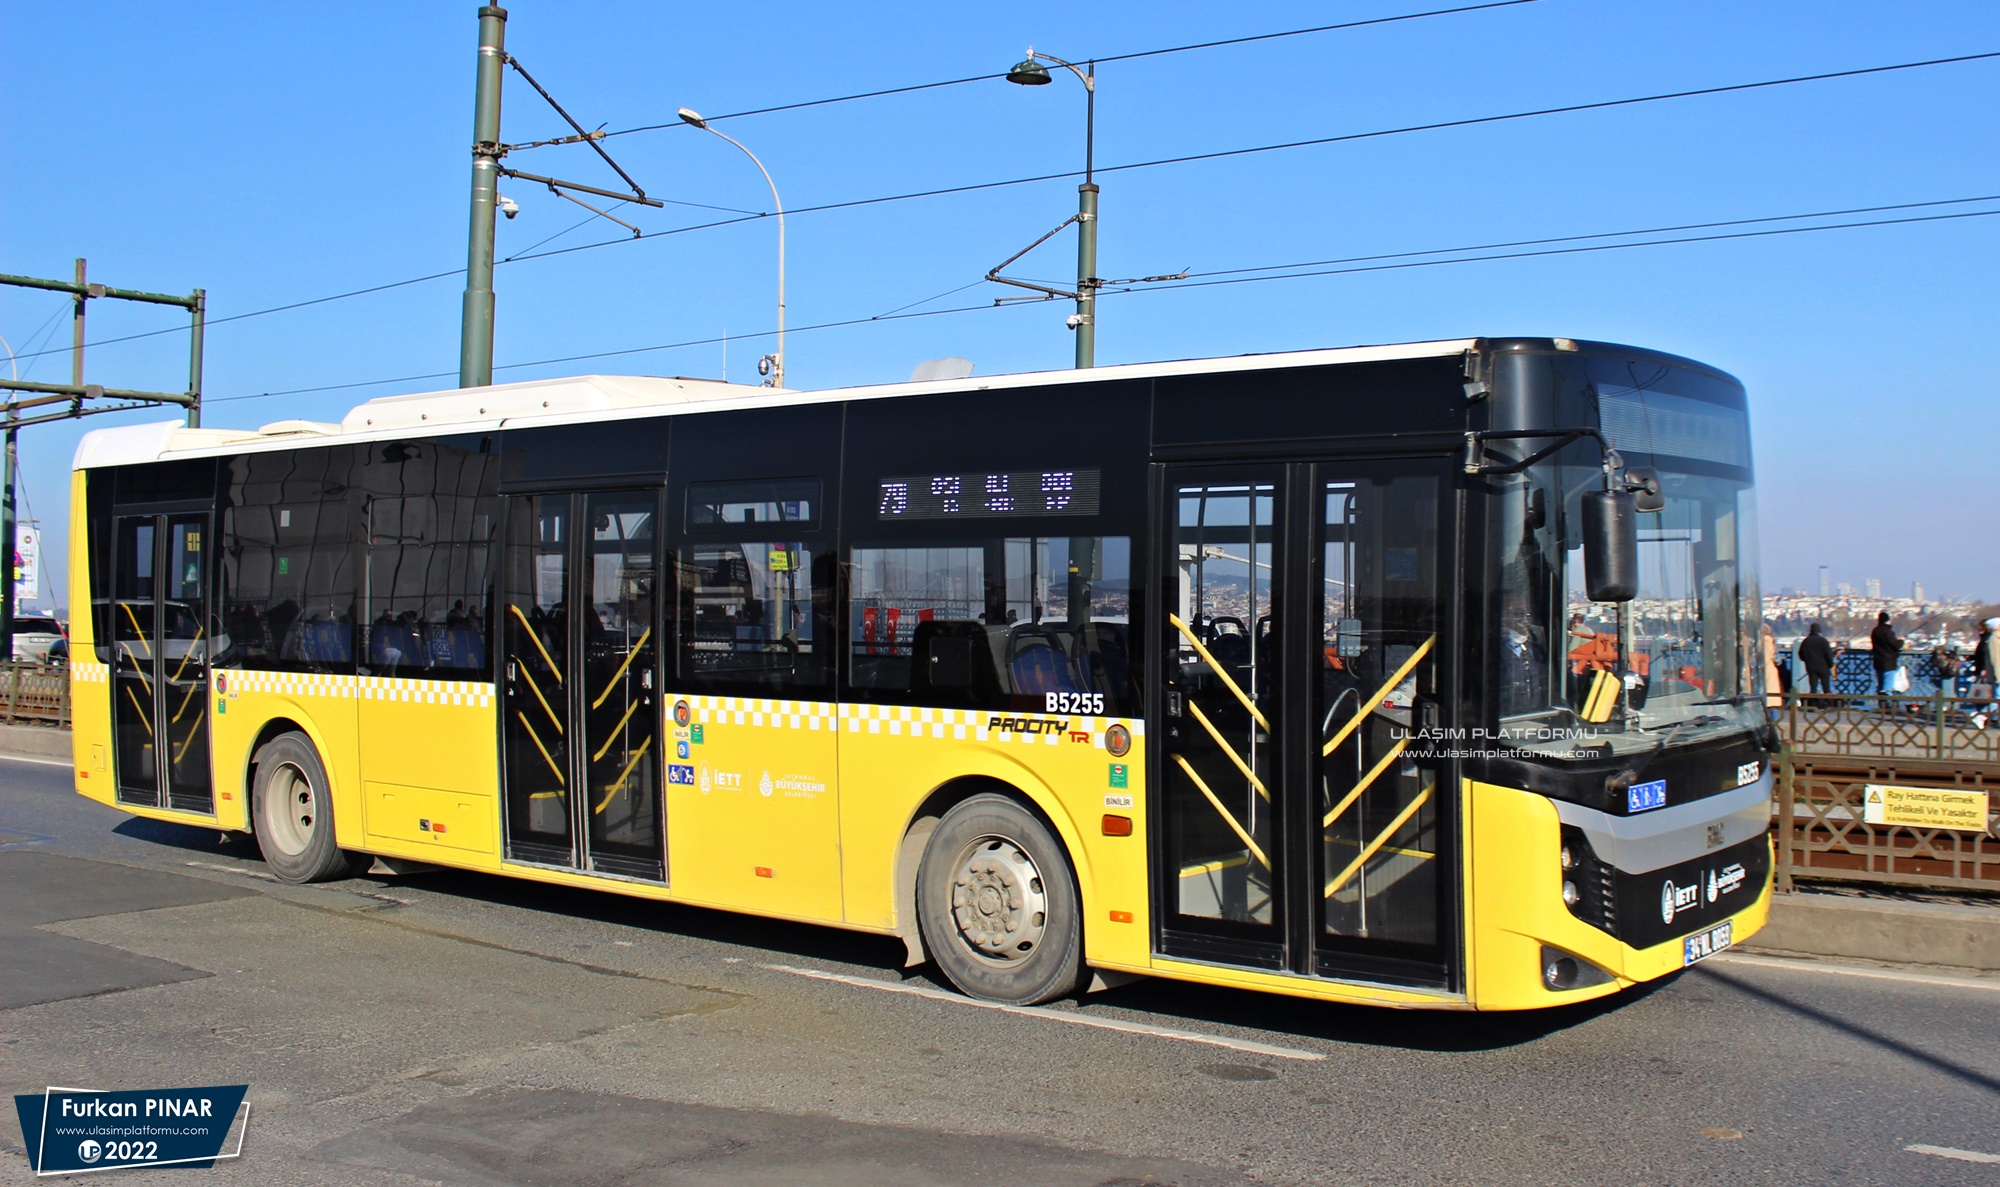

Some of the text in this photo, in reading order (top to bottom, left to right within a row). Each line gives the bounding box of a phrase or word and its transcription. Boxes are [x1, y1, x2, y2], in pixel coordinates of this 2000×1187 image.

[1045, 692, 1104, 714] B5255
[988, 717, 1090, 743] PROCITY TR
[714, 769, 742, 787] İETT
[775, 777, 826, 794] BÜYÜKŞEHİR
[1105, 797, 1131, 806] BİNİLİR
[1888, 790, 1904, 801] Ray
[1941, 794, 1975, 805] Girmek
[1887, 803, 1925, 815] Tehlikeli
[1926, 806, 1940, 815] Ve
[1675, 884, 1698, 907] İETT
